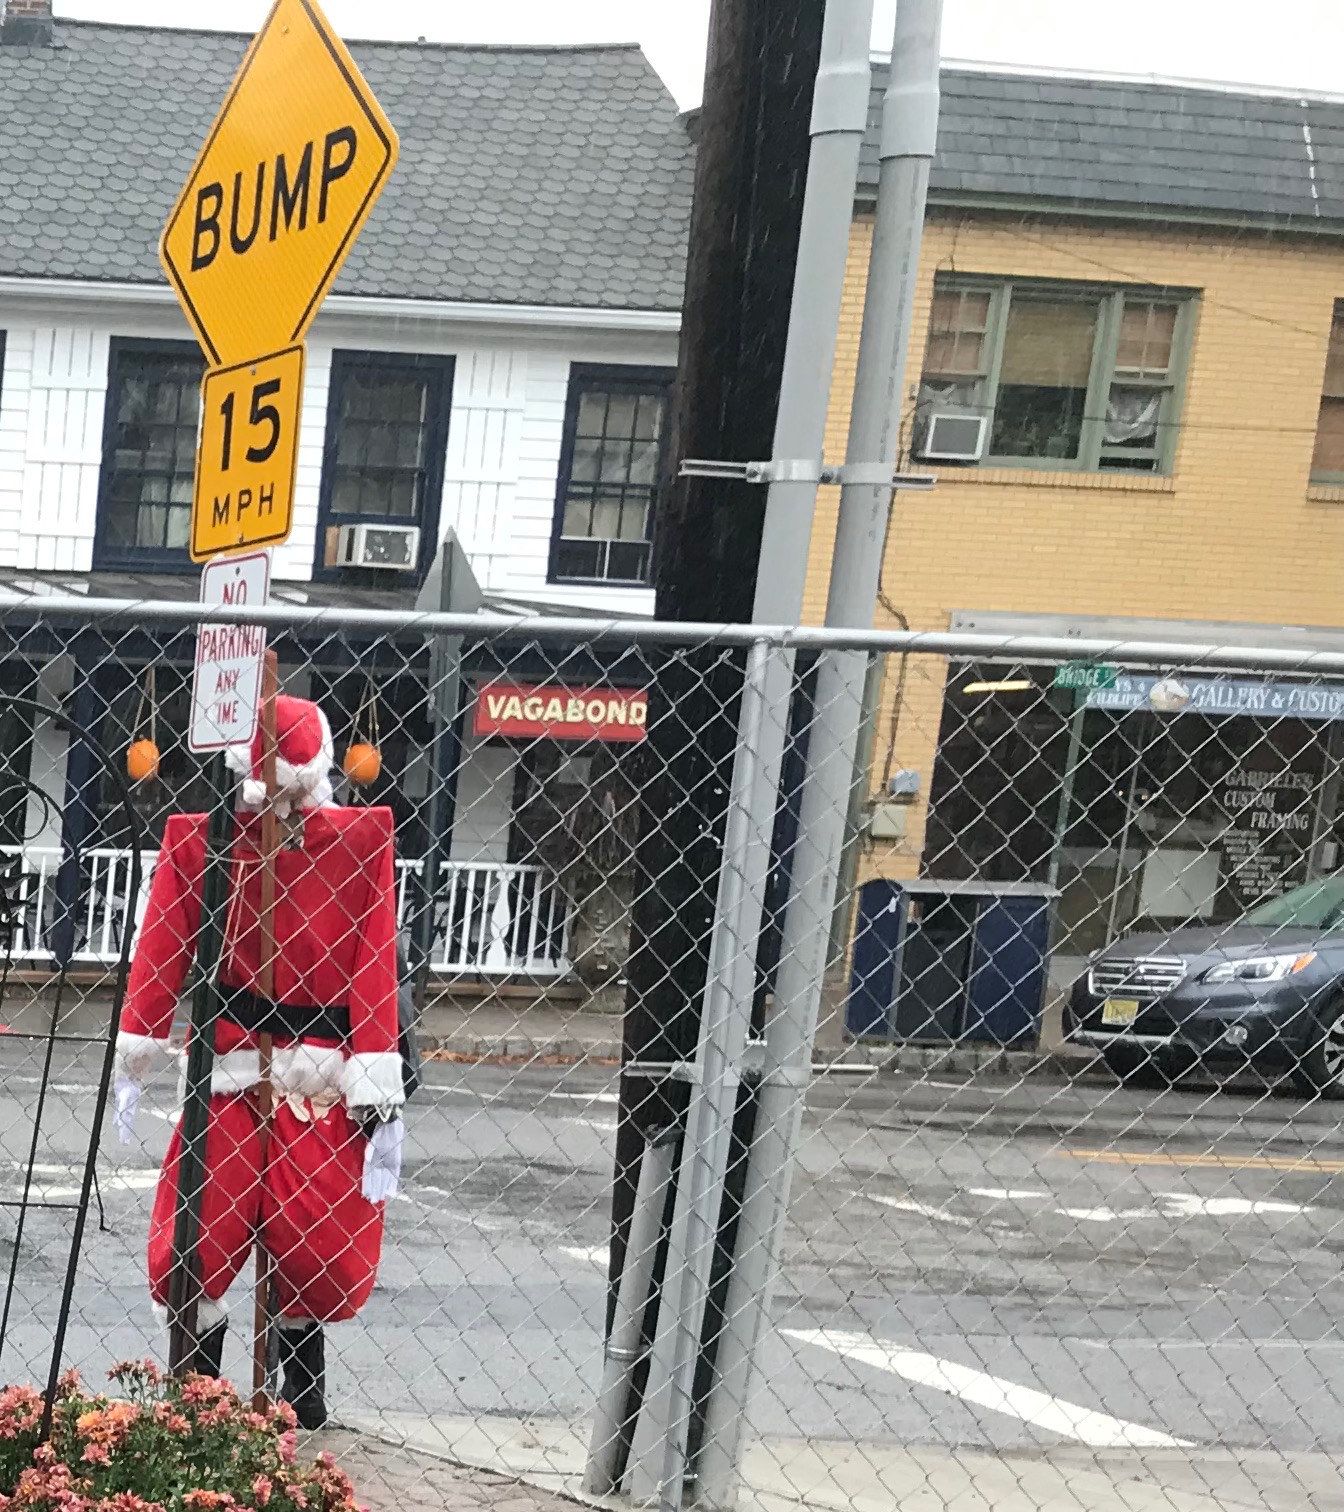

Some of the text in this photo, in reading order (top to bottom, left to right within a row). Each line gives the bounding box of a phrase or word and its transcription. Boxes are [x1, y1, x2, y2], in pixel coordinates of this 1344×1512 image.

[191, 125, 357, 272] BUMP
[220, 377, 281, 471] 15
[212, 481, 274, 528] MPH
[222, 579, 247, 605] NO
[201, 619, 259, 664] PARKING
[214, 668, 241, 695] ANY
[1191, 683, 1271, 709] GALLERY
[1271, 692, 1285, 709] &
[213, 700, 240, 725] IME
[487, 694, 648, 726] VAGABOND
